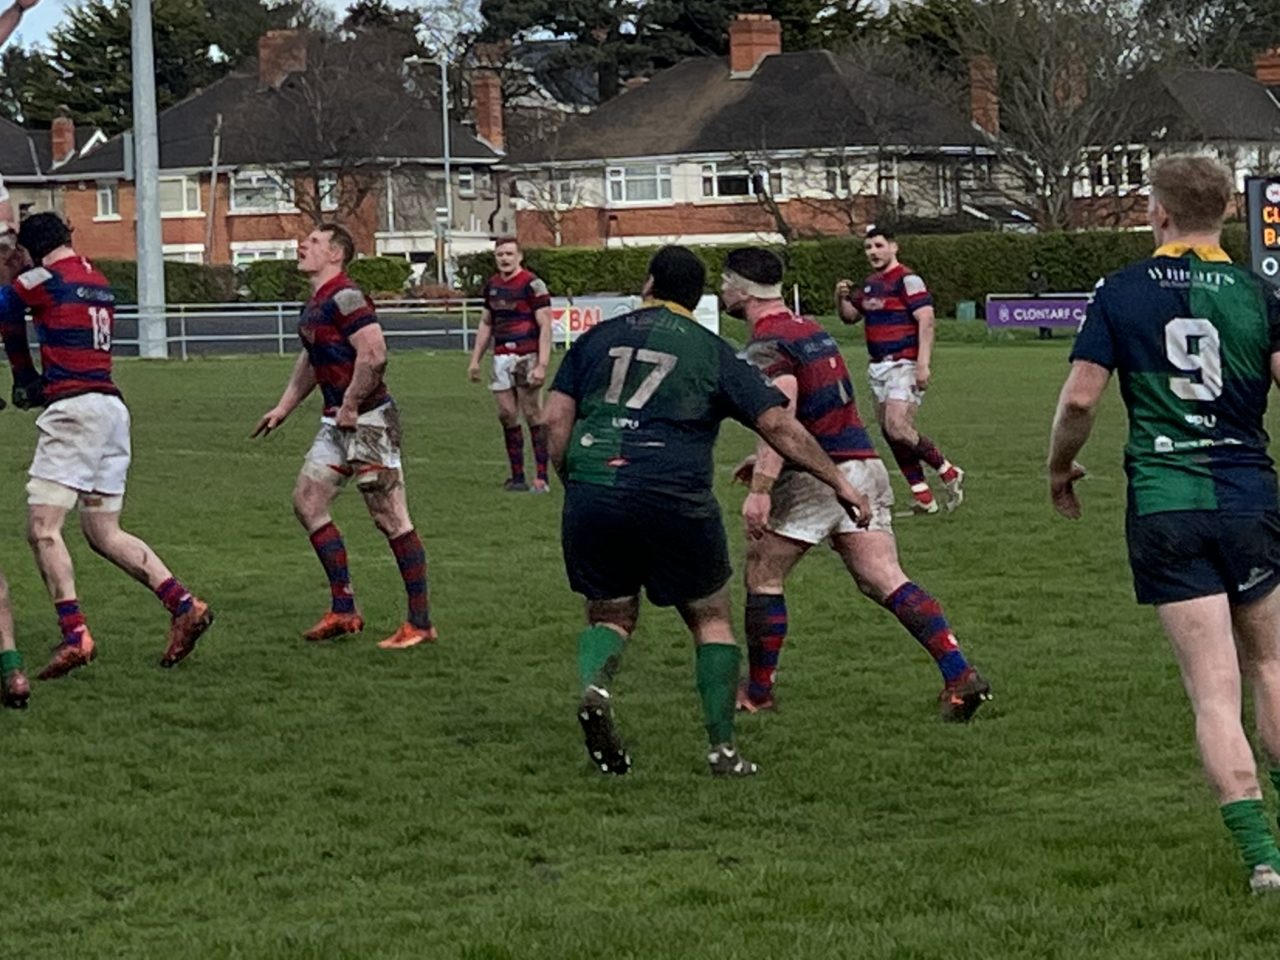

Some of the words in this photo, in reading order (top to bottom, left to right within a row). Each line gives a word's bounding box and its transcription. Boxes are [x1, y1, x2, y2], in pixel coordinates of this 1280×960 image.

[1013, 308, 1070, 320] CLONTARF
[604, 346, 678, 409] 17
[1165, 317, 1223, 401] 9
